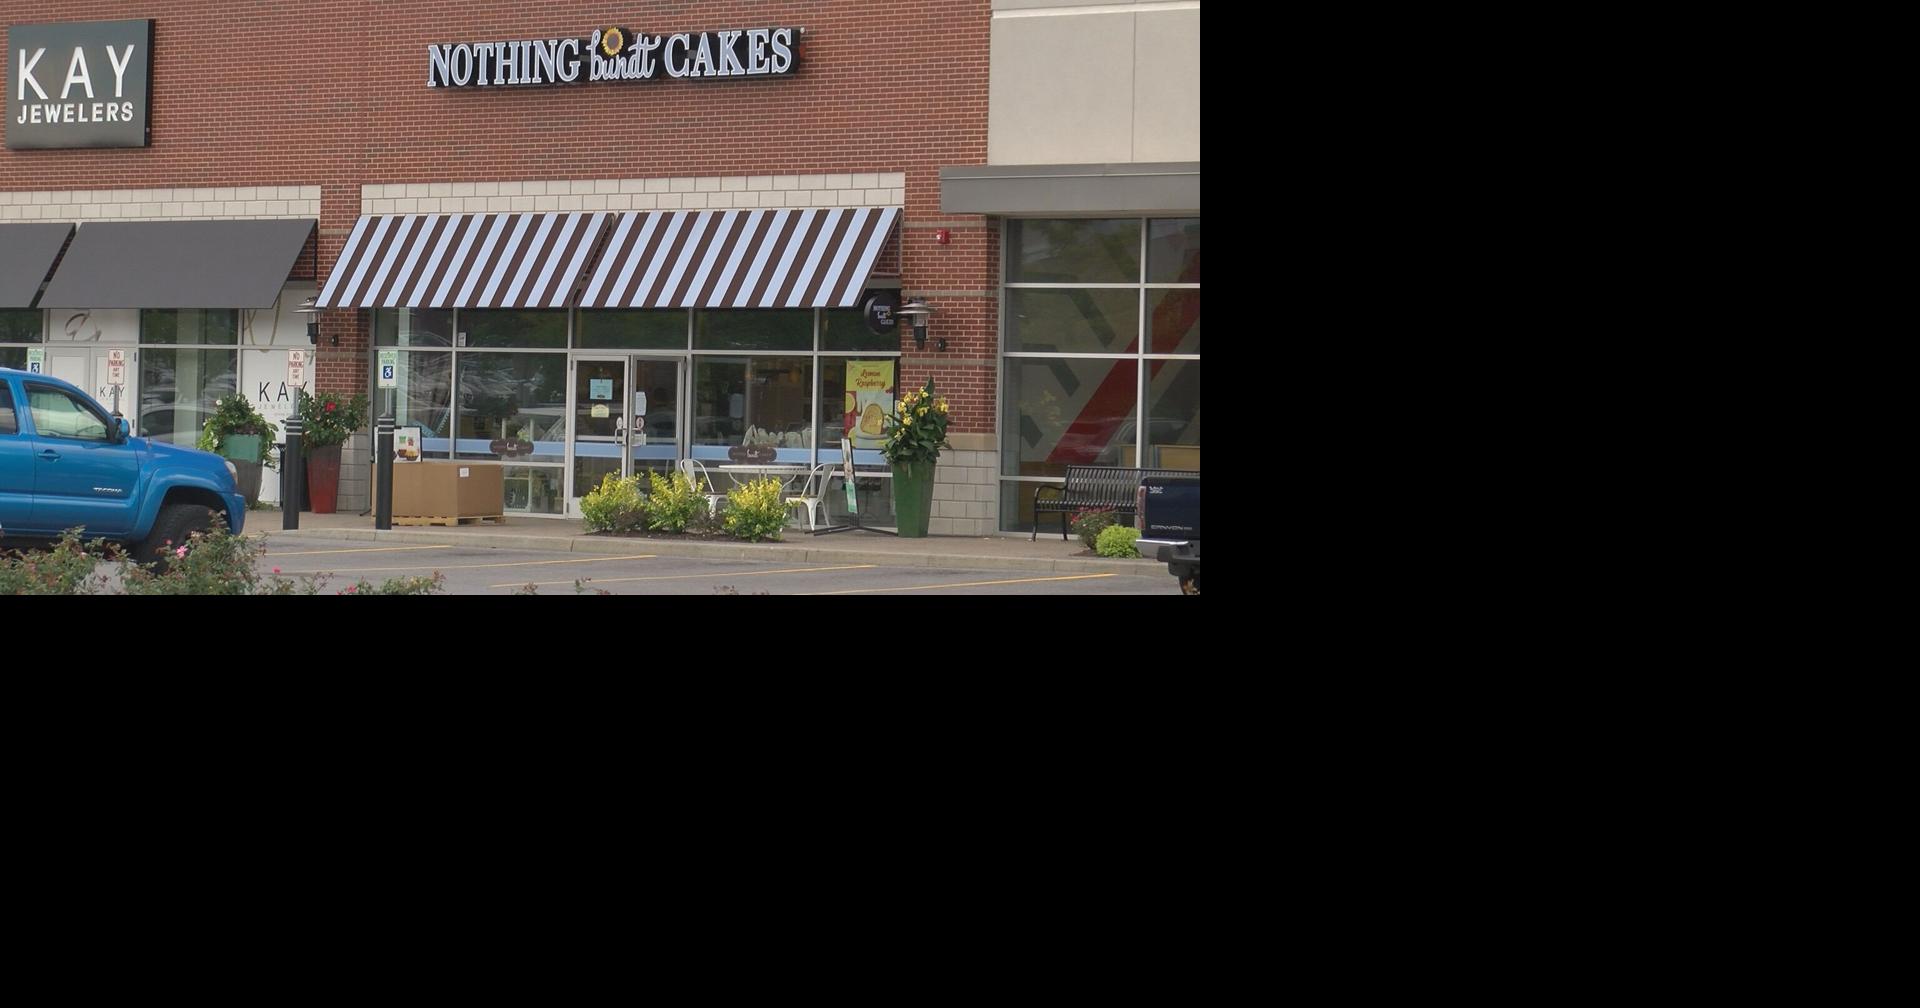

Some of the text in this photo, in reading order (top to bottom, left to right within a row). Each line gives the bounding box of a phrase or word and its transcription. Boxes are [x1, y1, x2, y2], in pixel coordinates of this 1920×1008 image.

[18, 44, 135, 100] KAY
[427, 27, 793, 88] NOTHING bundt CAKES
[17, 101, 134, 124] JEWELERS
